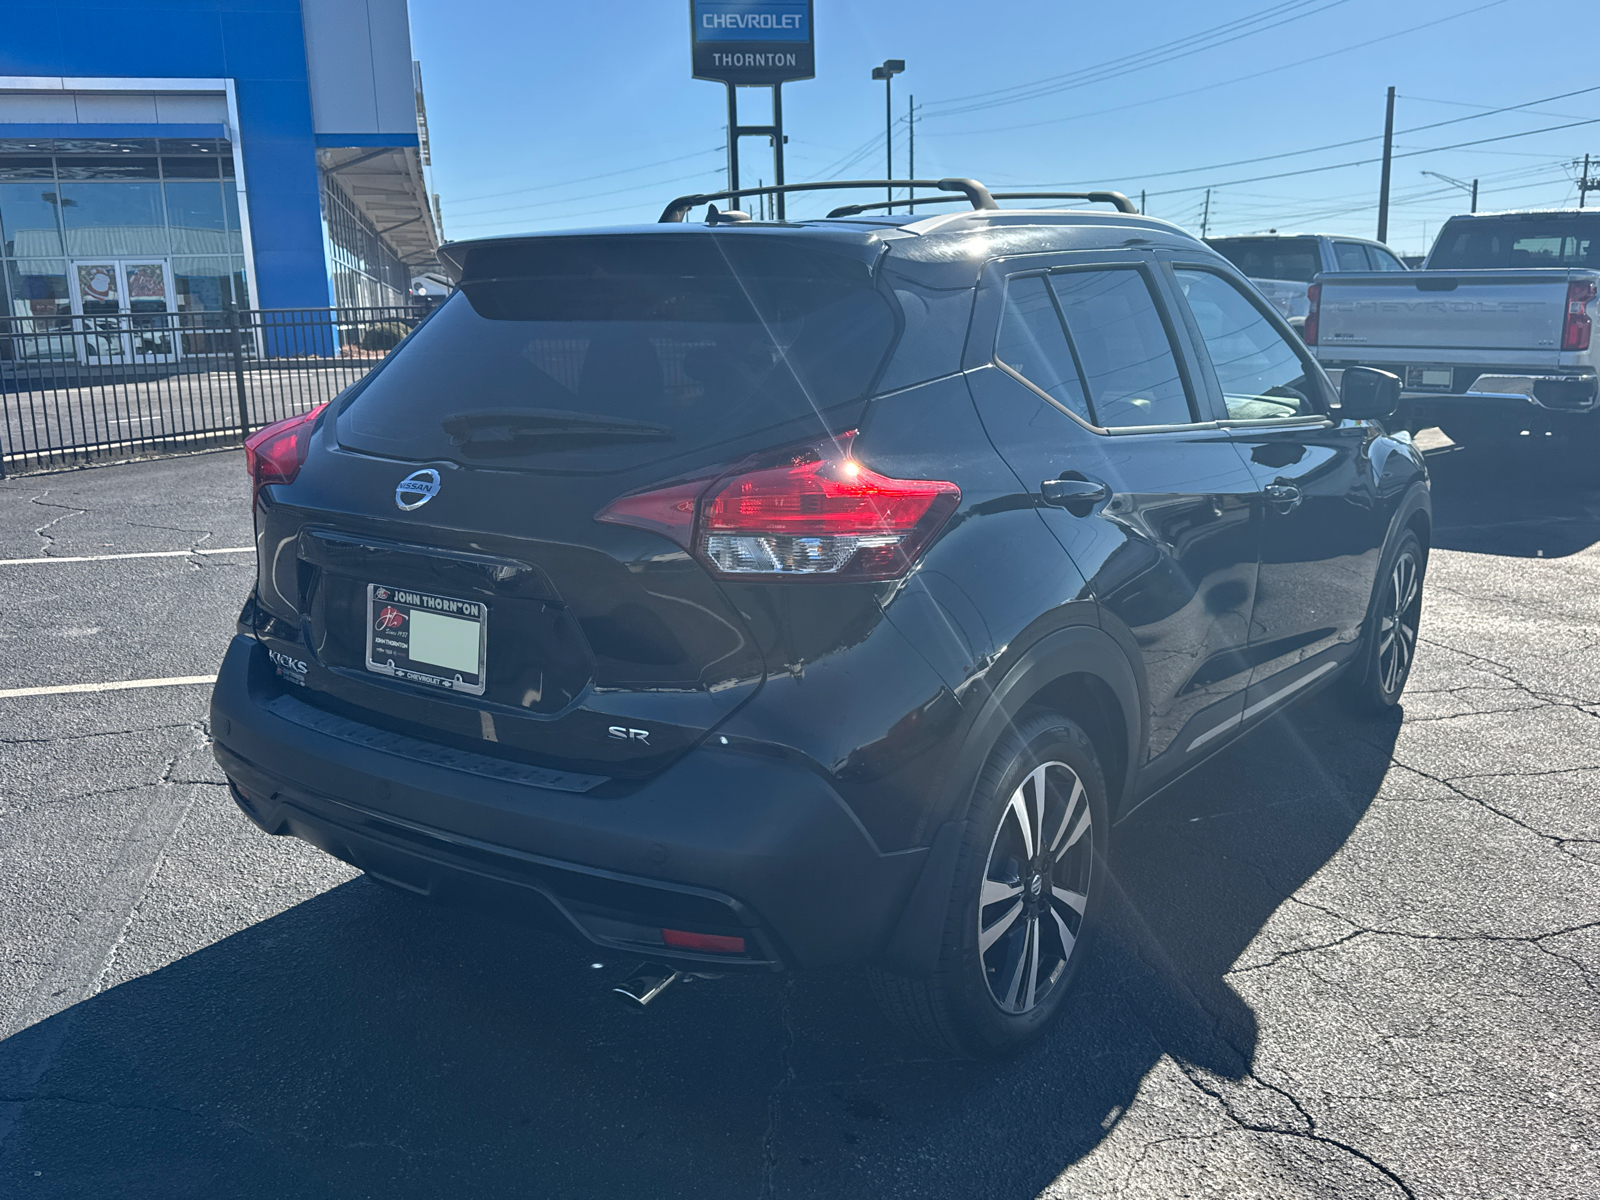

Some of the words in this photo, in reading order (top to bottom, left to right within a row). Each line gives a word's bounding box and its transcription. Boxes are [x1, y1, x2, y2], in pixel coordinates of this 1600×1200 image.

[702, 13, 802, 28] CHEVROLET
[713, 53, 796, 66] THORNTON
[1337, 301, 1546, 313] CHEVROLET
[399, 482, 433, 492] NISSAN
[393, 591, 421, 605] JOHN
[268, 649, 308, 674] KICKS
[407, 672, 441, 685] CHEVROLET
[608, 726, 650, 746] SR
